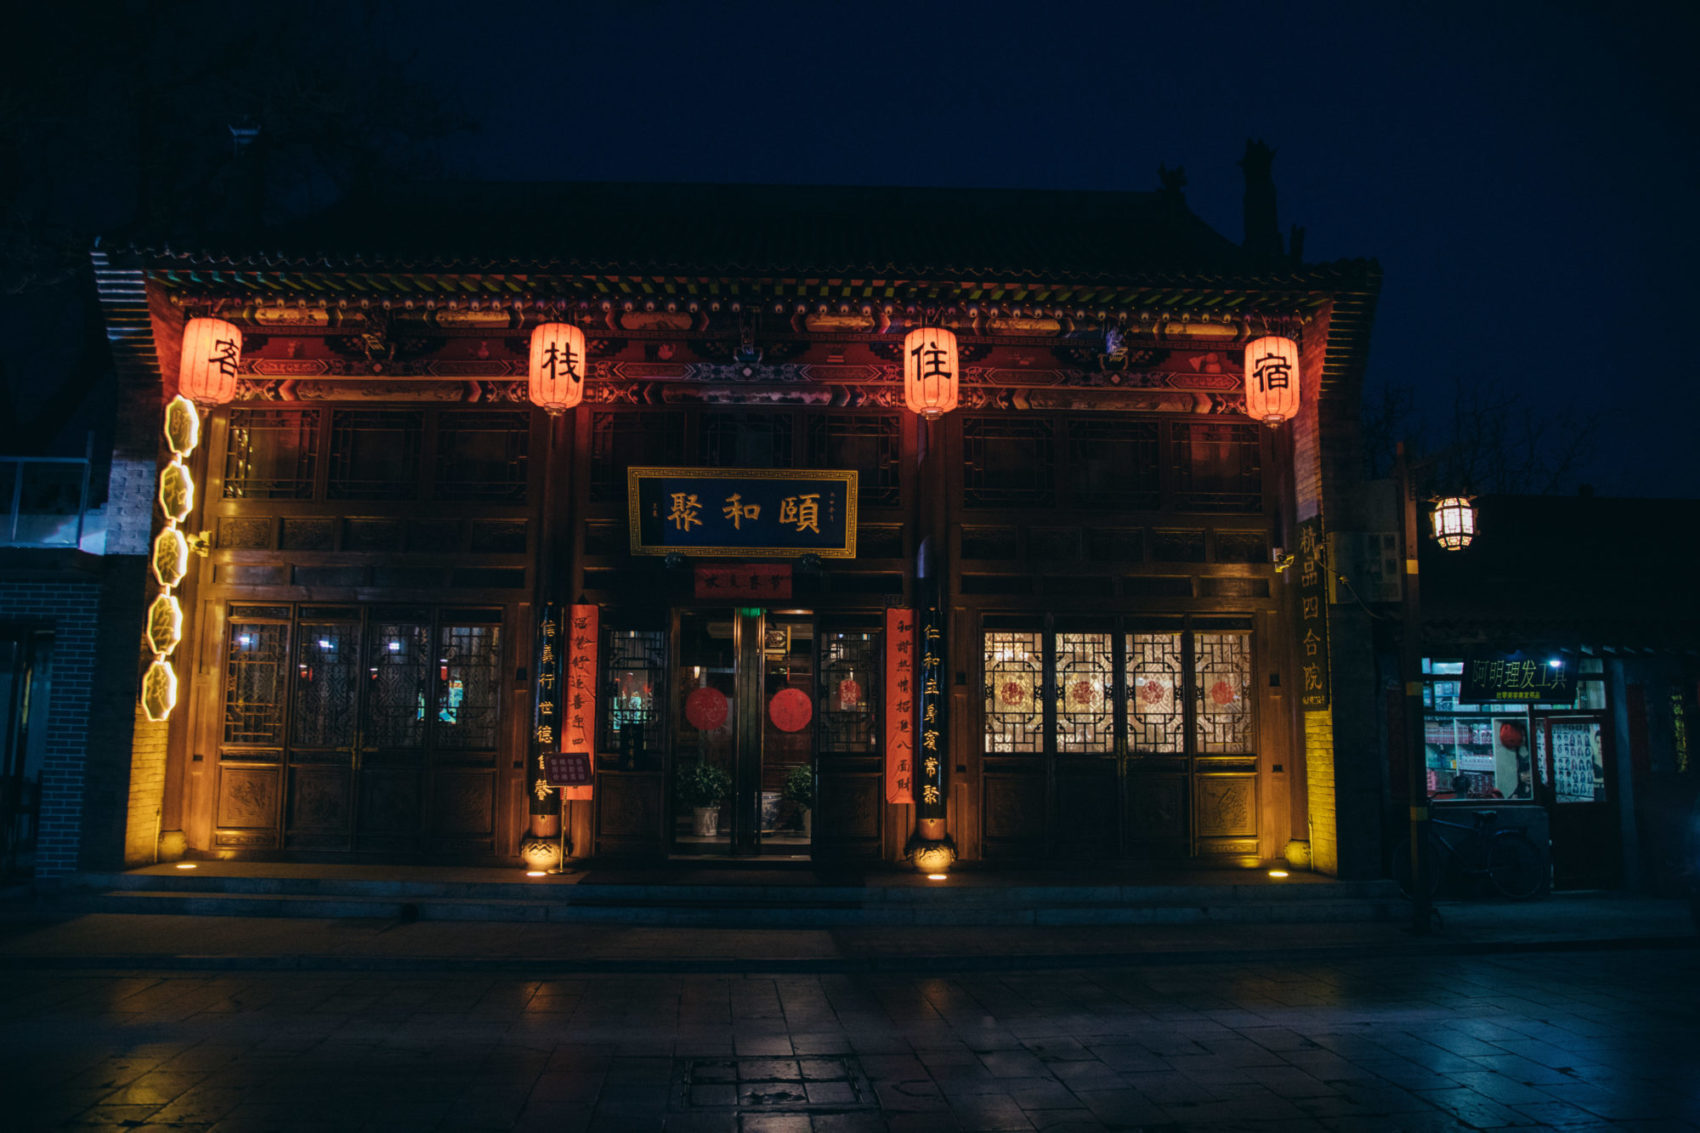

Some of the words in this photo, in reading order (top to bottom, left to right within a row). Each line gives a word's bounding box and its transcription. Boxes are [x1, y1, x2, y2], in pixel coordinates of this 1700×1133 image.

[208, 338, 240, 379] 客
[541, 341, 581, 384] 栈
[911, 341, 952, 382] 住
[1252, 352, 1292, 393] 宿
